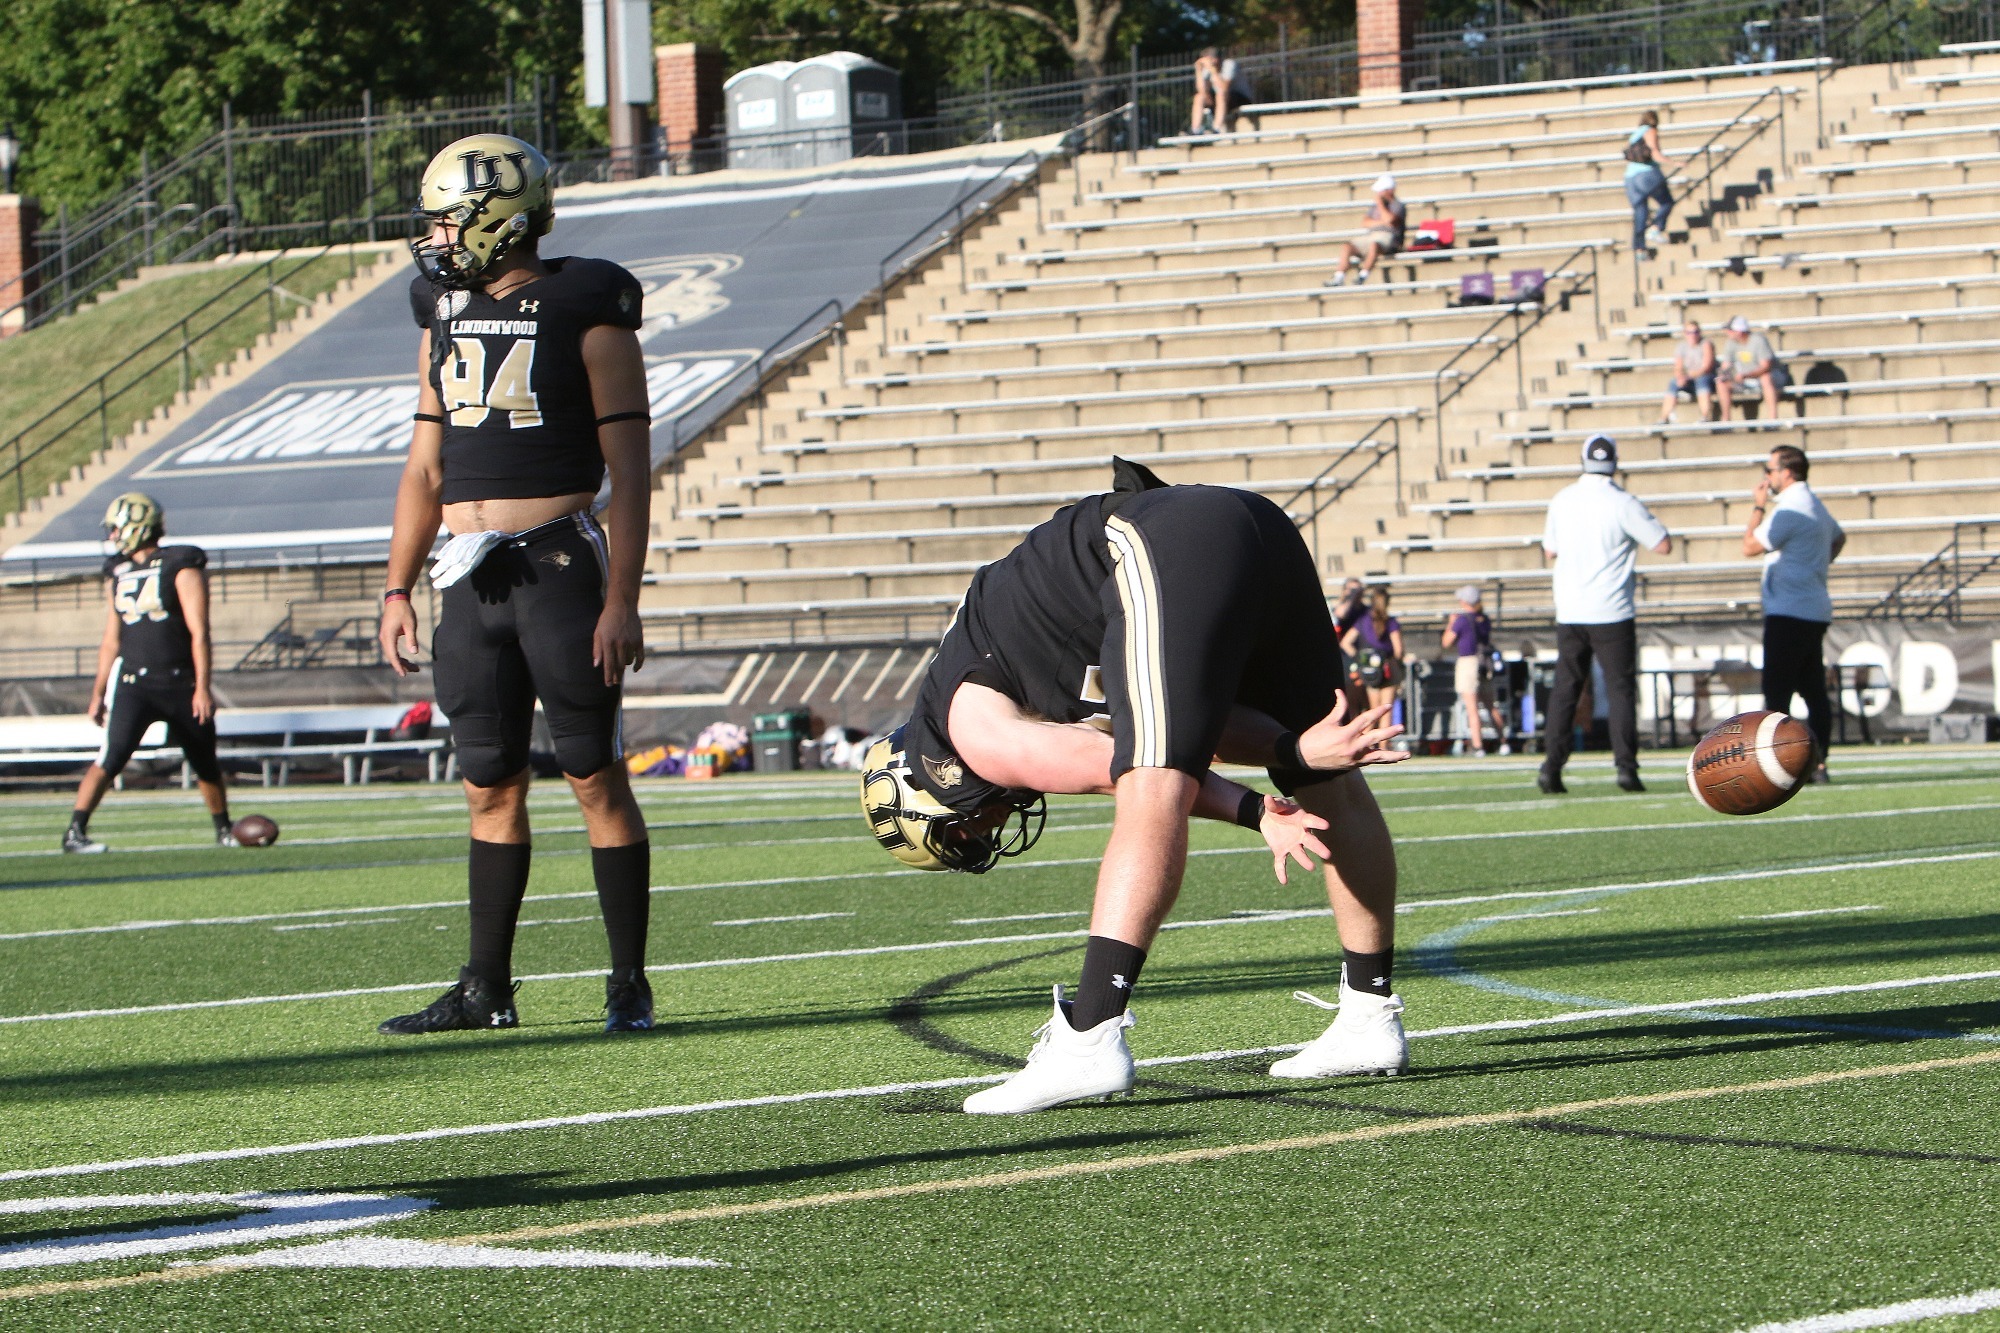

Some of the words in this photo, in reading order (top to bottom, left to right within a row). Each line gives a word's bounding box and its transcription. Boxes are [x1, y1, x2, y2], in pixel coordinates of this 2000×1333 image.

[456, 150, 527, 199] LU
[450, 320, 538, 335] LINDENWOOD
[115, 573, 169, 625] 54
